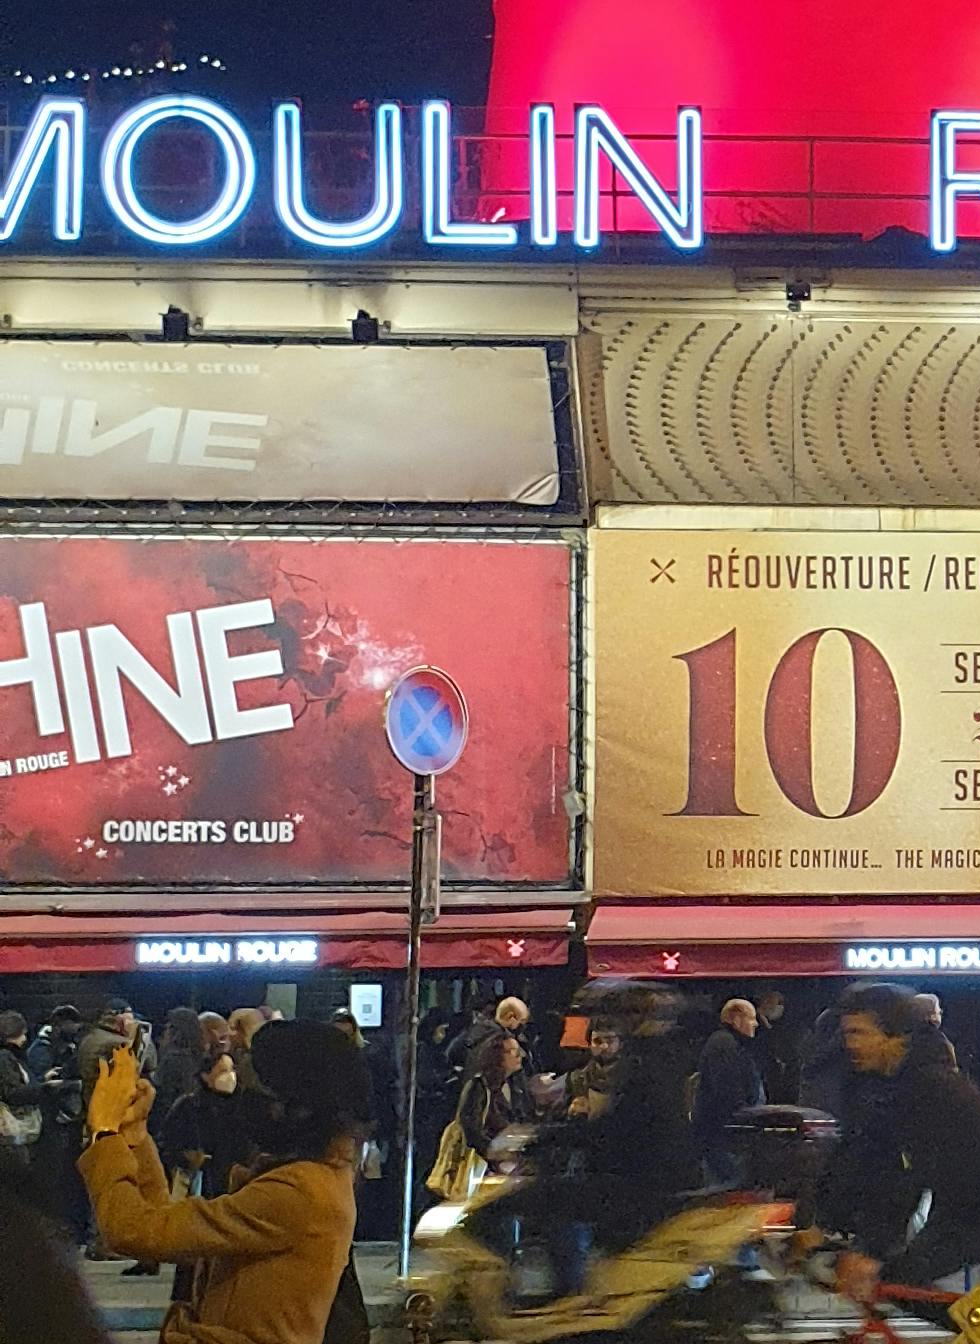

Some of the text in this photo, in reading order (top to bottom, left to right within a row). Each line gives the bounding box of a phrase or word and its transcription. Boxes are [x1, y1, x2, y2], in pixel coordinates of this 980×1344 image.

[707, 547, 911, 590] RÉOUVERTURE
[663, 627, 902, 818] 10
[15, 751, 70, 774] ROUGE
[103, 820, 295, 843] CONCERTS CLUB
[706, 849, 725, 869] LA
[732, 849, 782, 869] MAGIE
[895, 849, 924, 869] THE
[138, 940, 318, 963] MOULIN ROUGE
[847, 947, 936, 968] MOULIN
